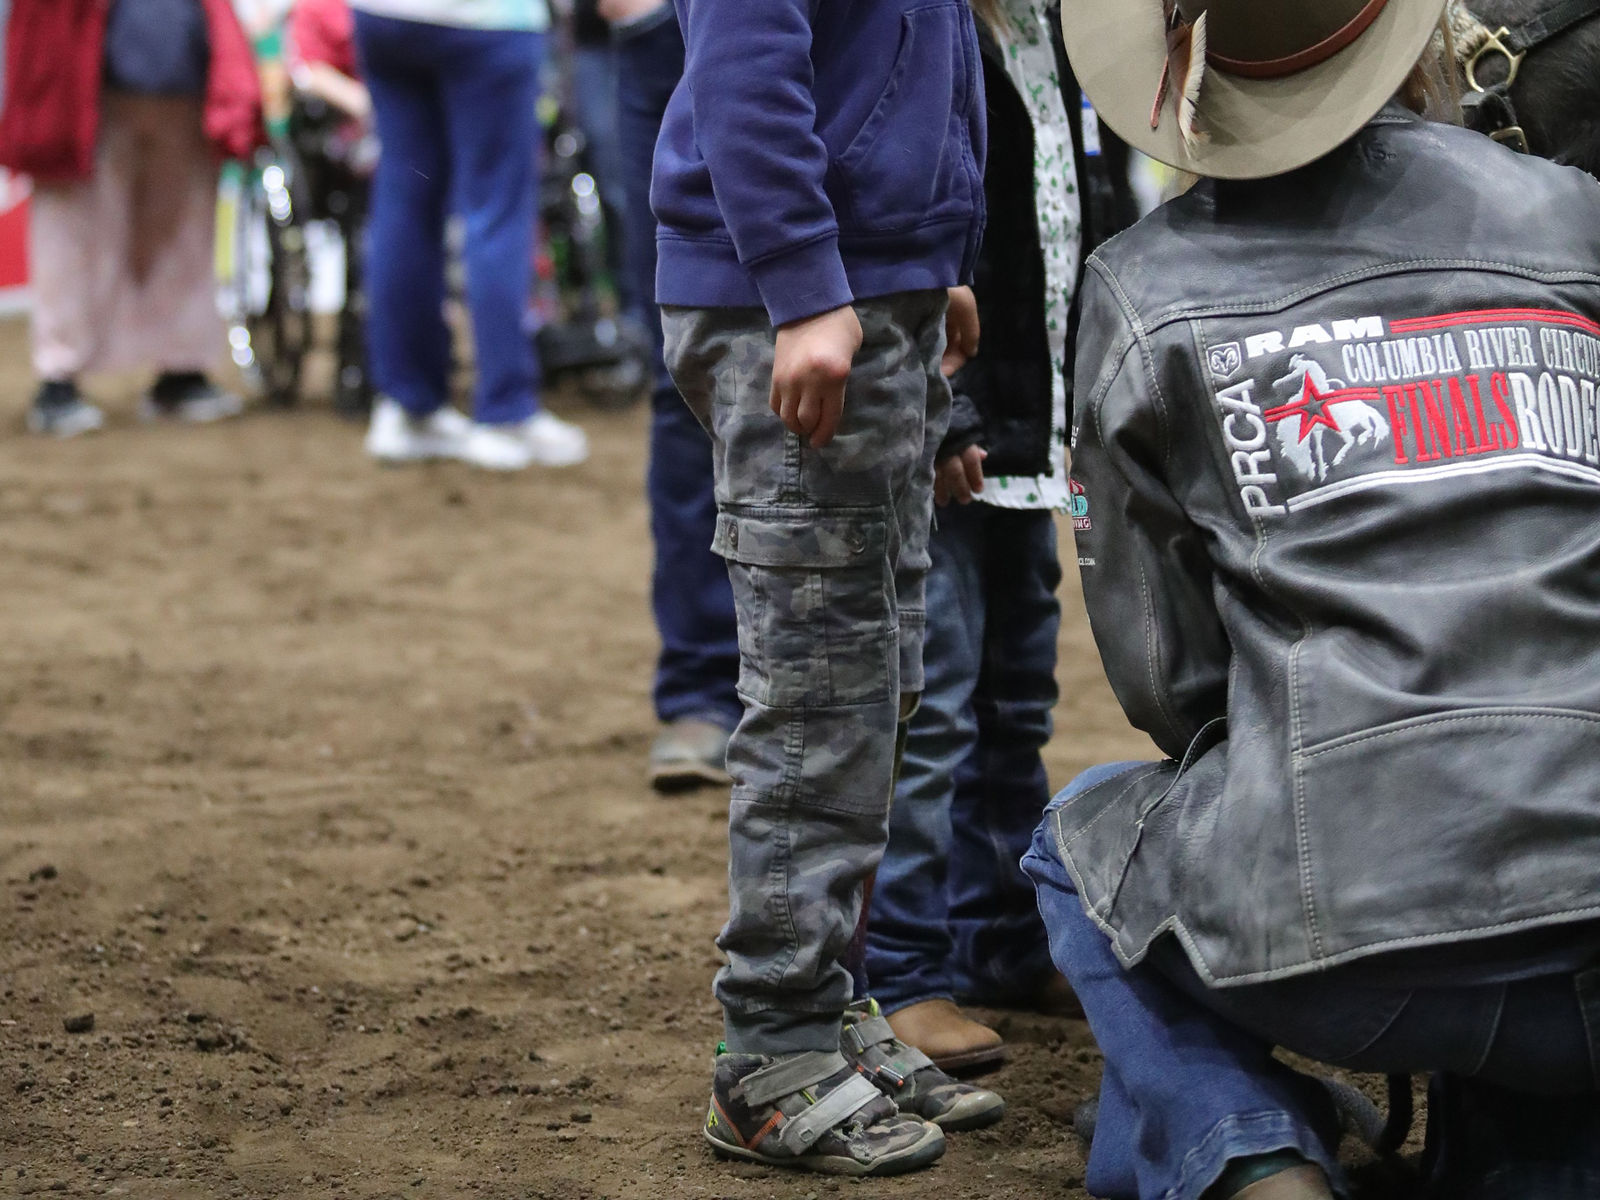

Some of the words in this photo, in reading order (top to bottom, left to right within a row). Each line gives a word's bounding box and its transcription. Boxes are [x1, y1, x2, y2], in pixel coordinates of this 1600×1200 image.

[1244, 316, 1385, 358] RAM
[1341, 332, 1462, 384] COLUMBIA
[1464, 326, 1537, 369] RIVER
[1539, 327, 1600, 378] CIRCUI
[1215, 379, 1287, 515] PRCA
[1382, 372, 1519, 465] FINALS
